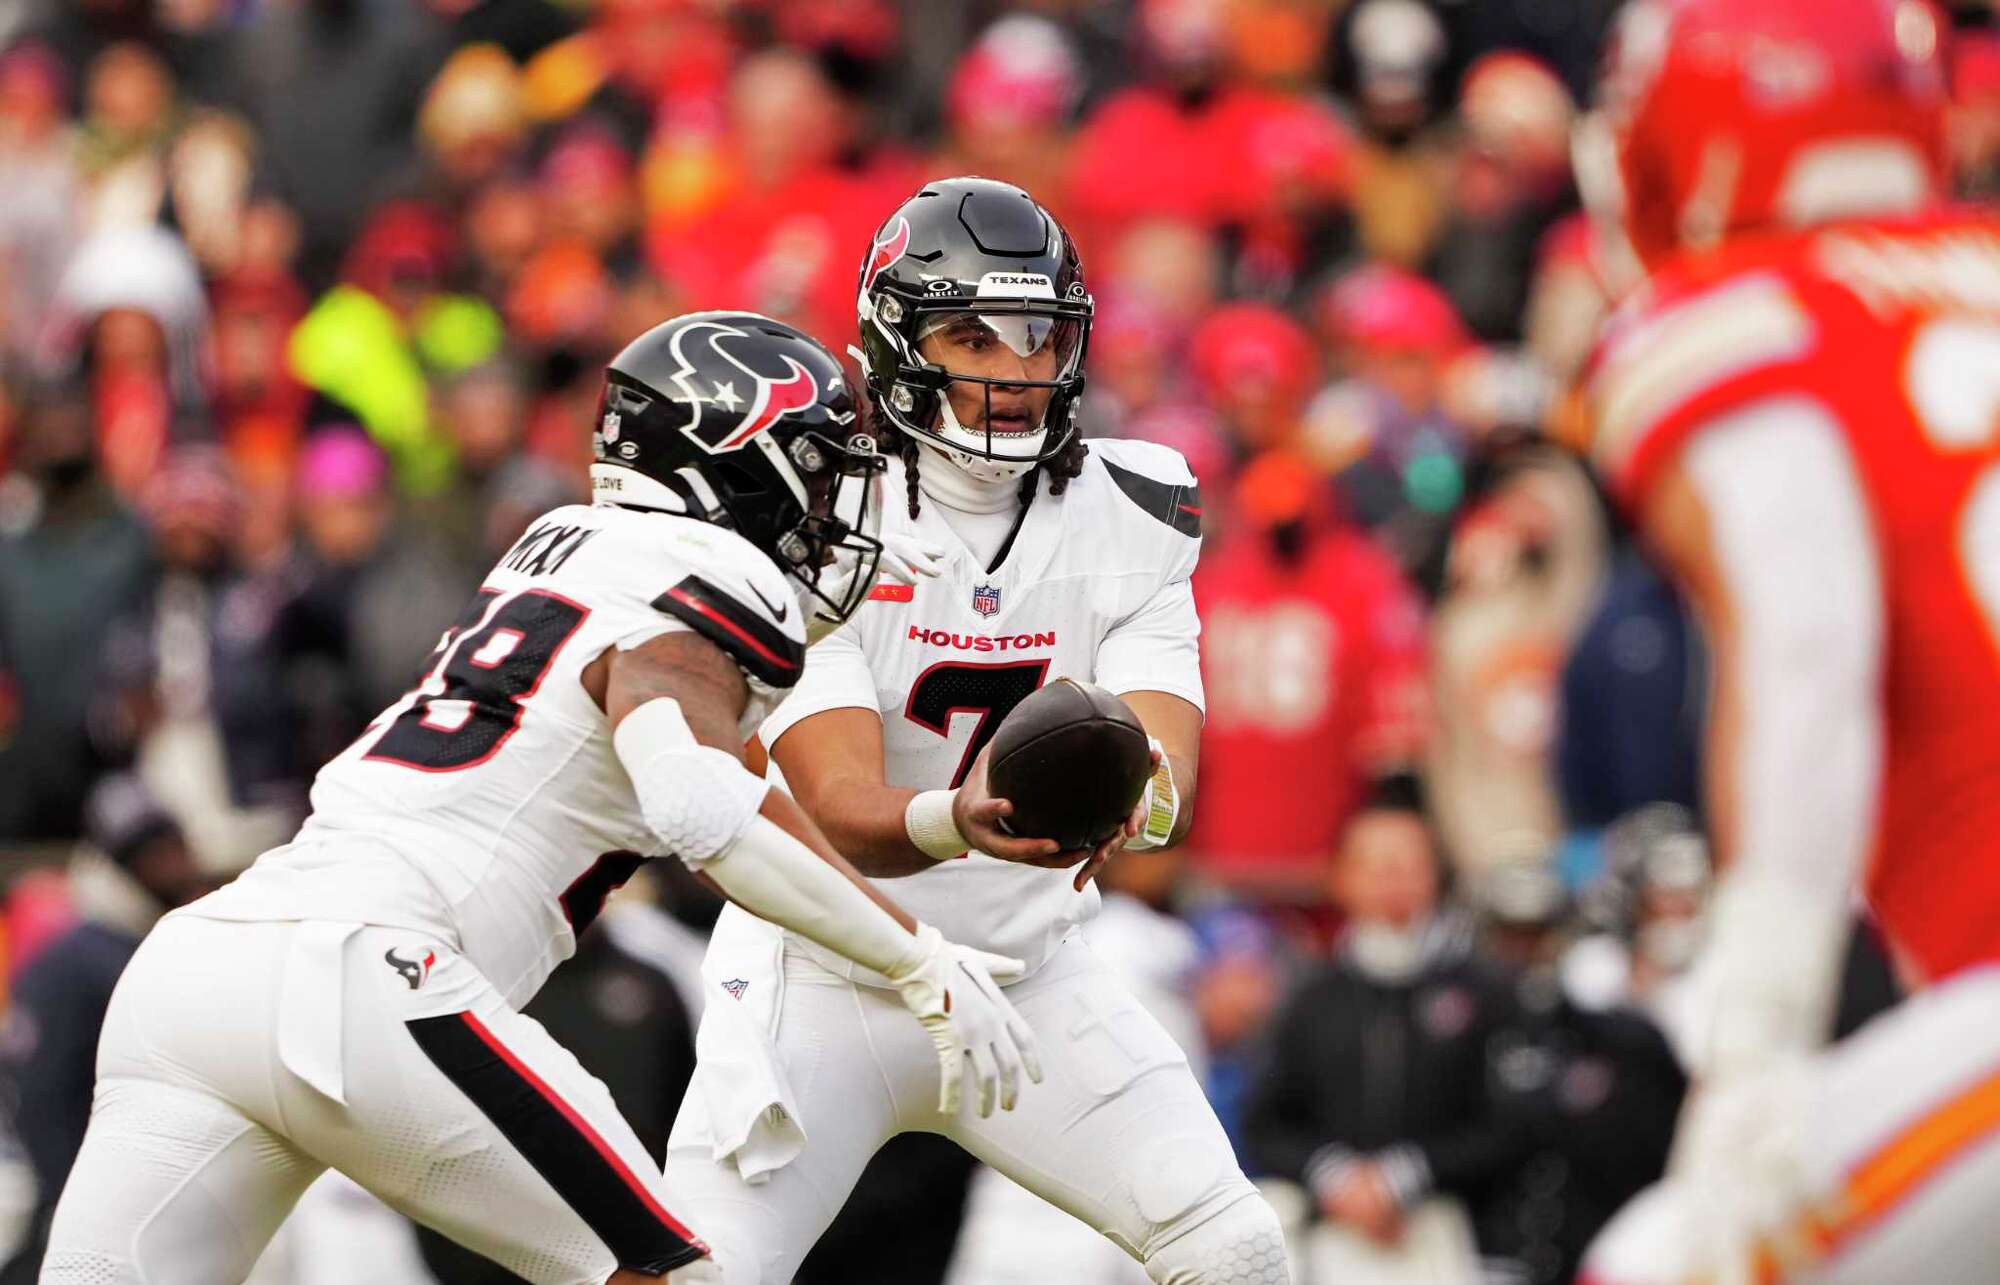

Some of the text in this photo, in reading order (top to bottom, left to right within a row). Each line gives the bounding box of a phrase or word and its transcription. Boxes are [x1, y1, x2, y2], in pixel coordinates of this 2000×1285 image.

[989, 276, 1048, 286] TEXANS
[975, 597, 997, 612] NFL
[907, 625, 1056, 652] HOUSTON
[904, 658, 1052, 859] 7
